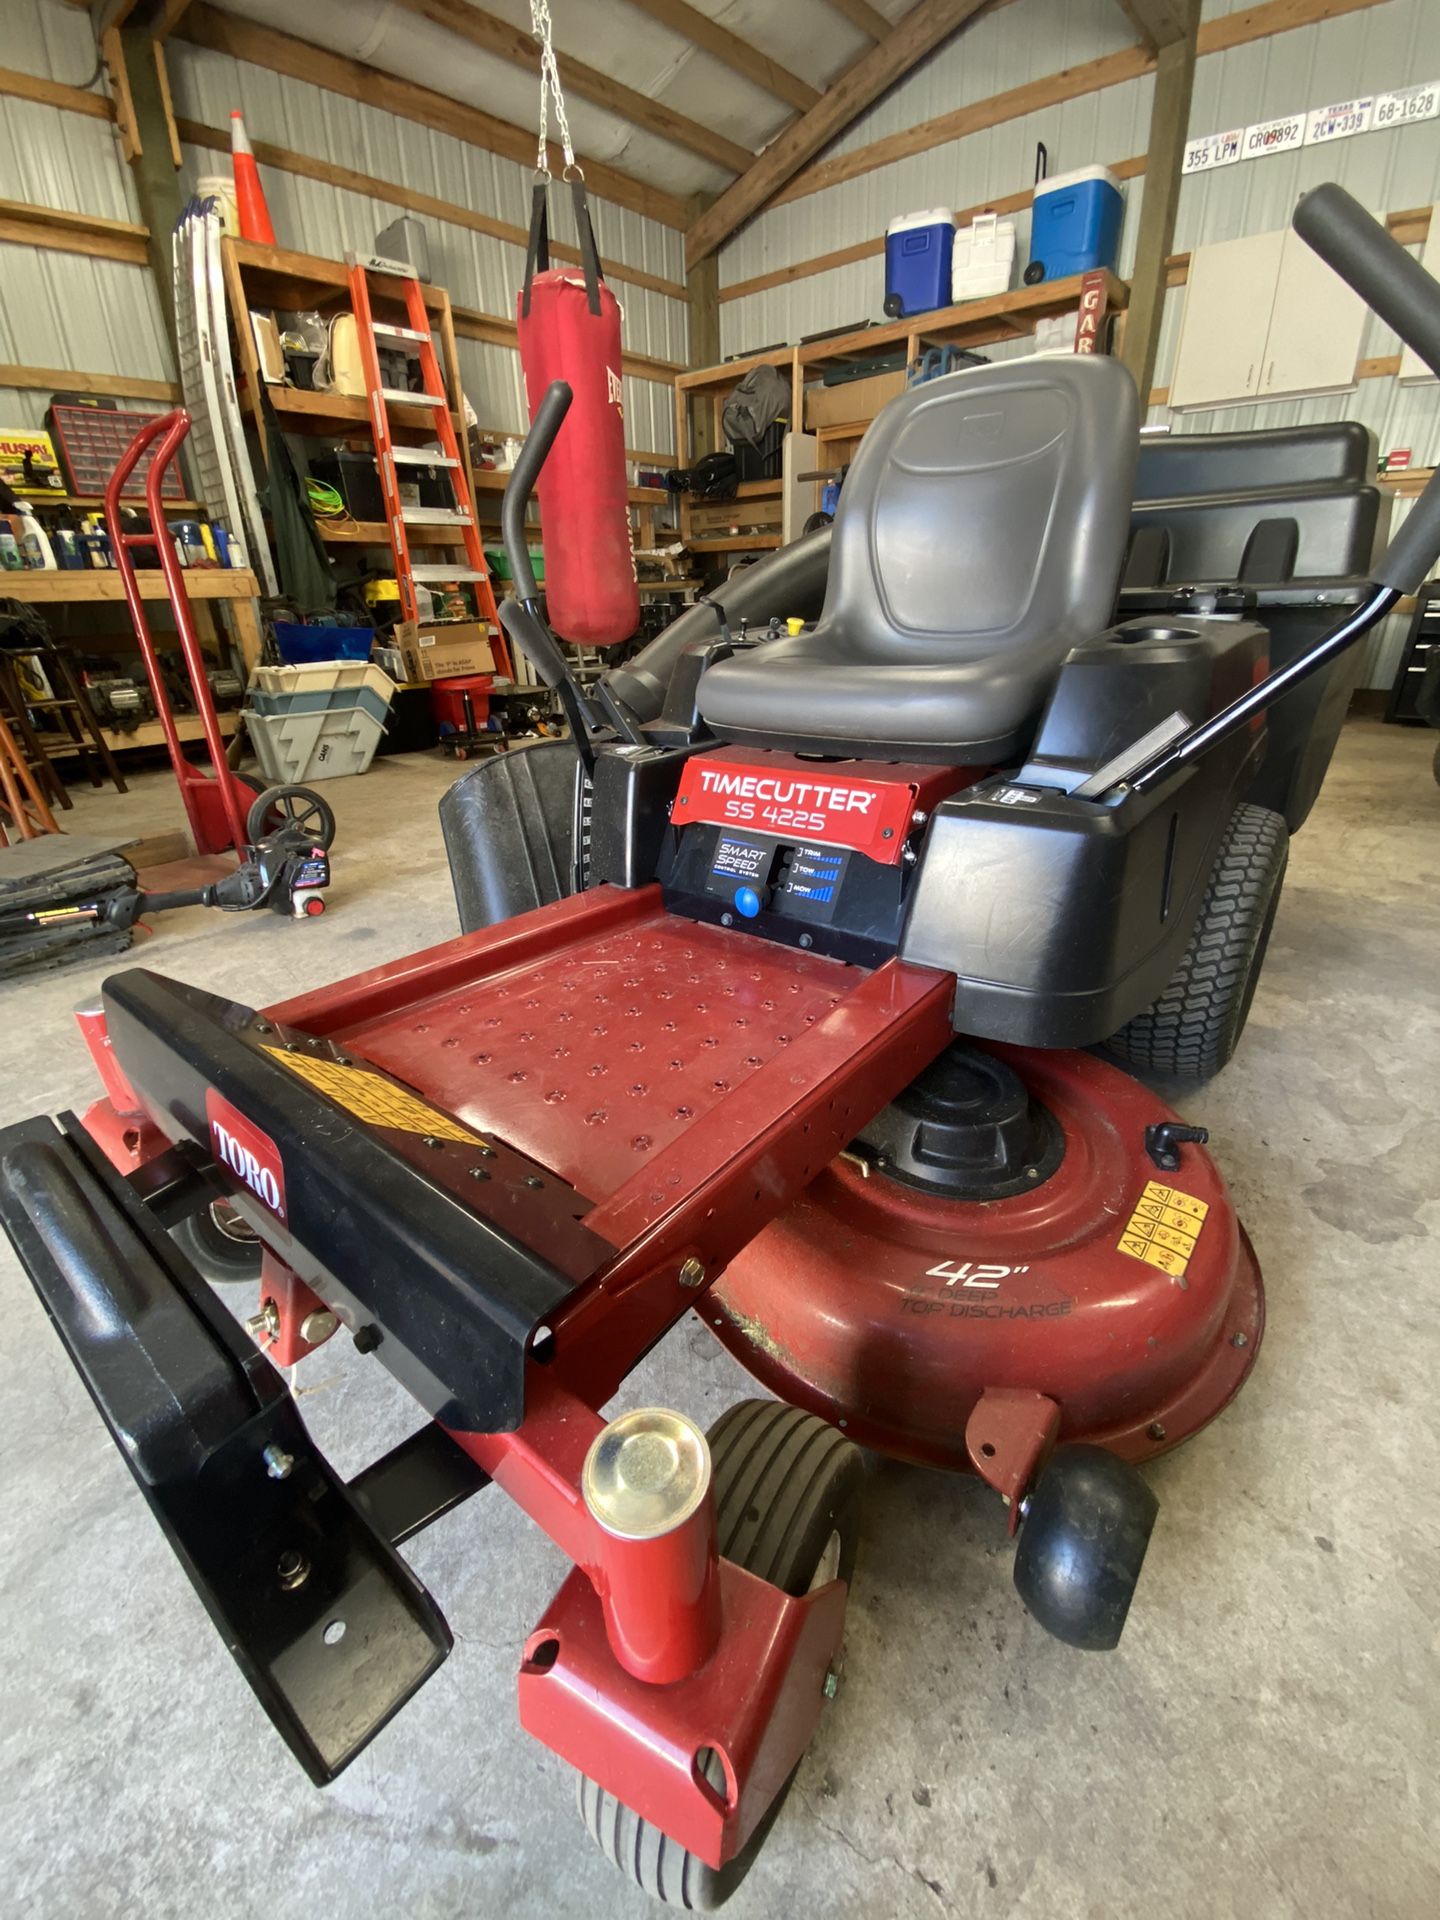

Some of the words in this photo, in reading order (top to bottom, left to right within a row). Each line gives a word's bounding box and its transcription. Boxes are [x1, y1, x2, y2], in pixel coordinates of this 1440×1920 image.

[1378, 94, 1434, 122] 68-1628
[1187, 148, 1209, 168] 355
[1214, 141, 1237, 160] LPM
[701, 771, 873, 814] TIMECUTTER
[724, 800, 756, 820] SS
[762, 805, 826, 831] 4225
[719, 843, 767, 861] SMART
[804, 849, 821, 857] TRIM
[714, 864, 736, 873] CONTROL
[739, 870, 760, 878] SYSTEM
[716, 854, 758, 871] SPEED
[799, 866, 814, 874] TOW
[793, 885, 811, 893] MOW
[925, 1260, 1030, 1289] 42"
[939, 1287, 998, 1302] DEEP
[902, 1298, 945, 1317] TOP
[951, 1301, 1073, 1318] DISCHARGE
